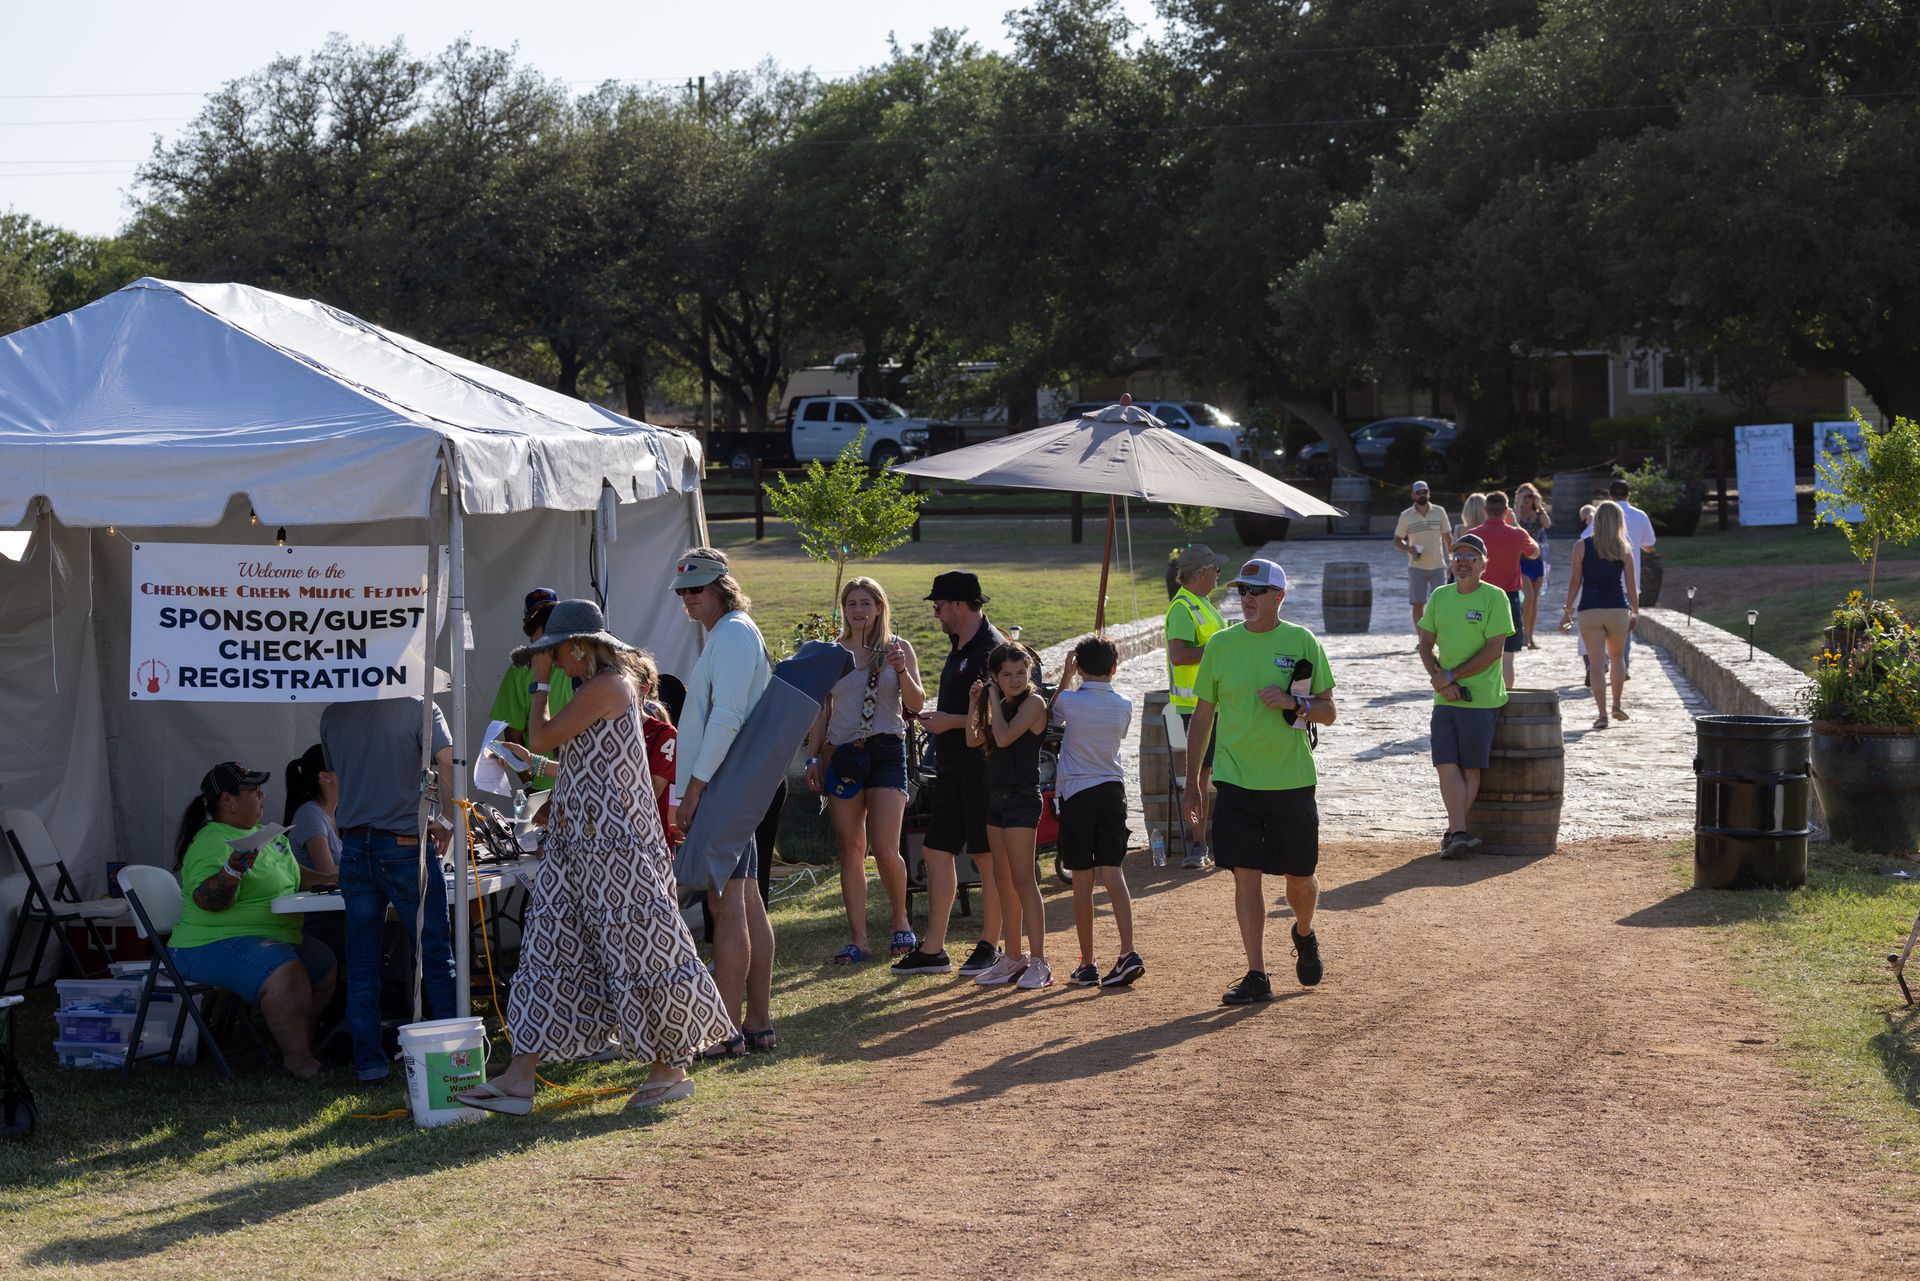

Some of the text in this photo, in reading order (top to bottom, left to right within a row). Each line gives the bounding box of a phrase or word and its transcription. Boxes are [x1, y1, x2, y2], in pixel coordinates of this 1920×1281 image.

[238, 562, 345, 579] Welcome to the
[141, 582, 228, 598] CHEROKEE
[236, 585, 290, 598] CREEK
[299, 585, 356, 599] MUSIC
[159, 607, 425, 635] SPONSOR/GUEST
[218, 637, 367, 661] CHECK-IN
[178, 665, 407, 689] REGISTRATION
[660, 738, 676, 762] 4
